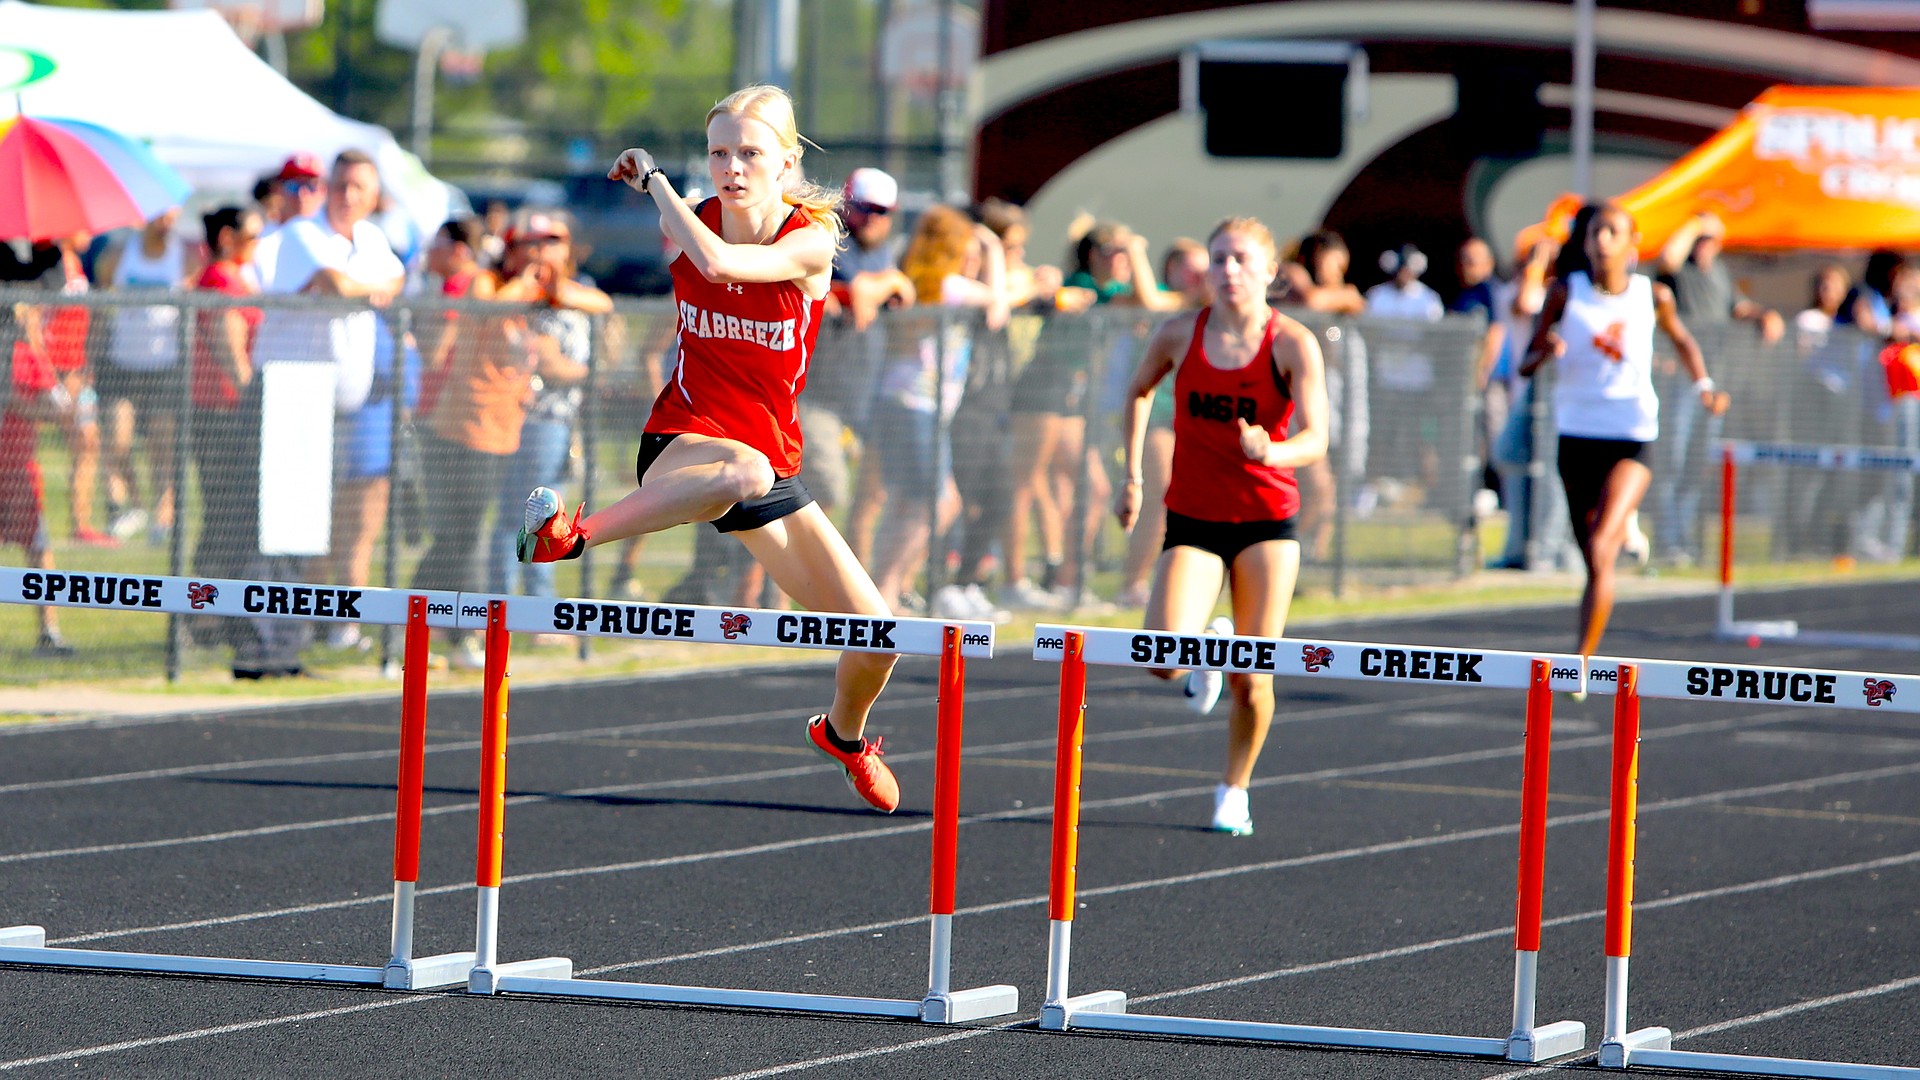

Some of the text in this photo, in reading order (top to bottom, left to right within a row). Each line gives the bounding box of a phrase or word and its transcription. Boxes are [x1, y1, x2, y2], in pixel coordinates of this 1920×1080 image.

[21, 572, 163, 608] SPRUCE
[243, 585, 362, 619] CREEK
[553, 602, 696, 638] SPRUCE
[776, 614, 897, 649] CREEK
[1130, 634, 1276, 671] SPRUCE
[1359, 648, 1483, 683] CREEK
[1686, 666, 1837, 704] SPRUCE
